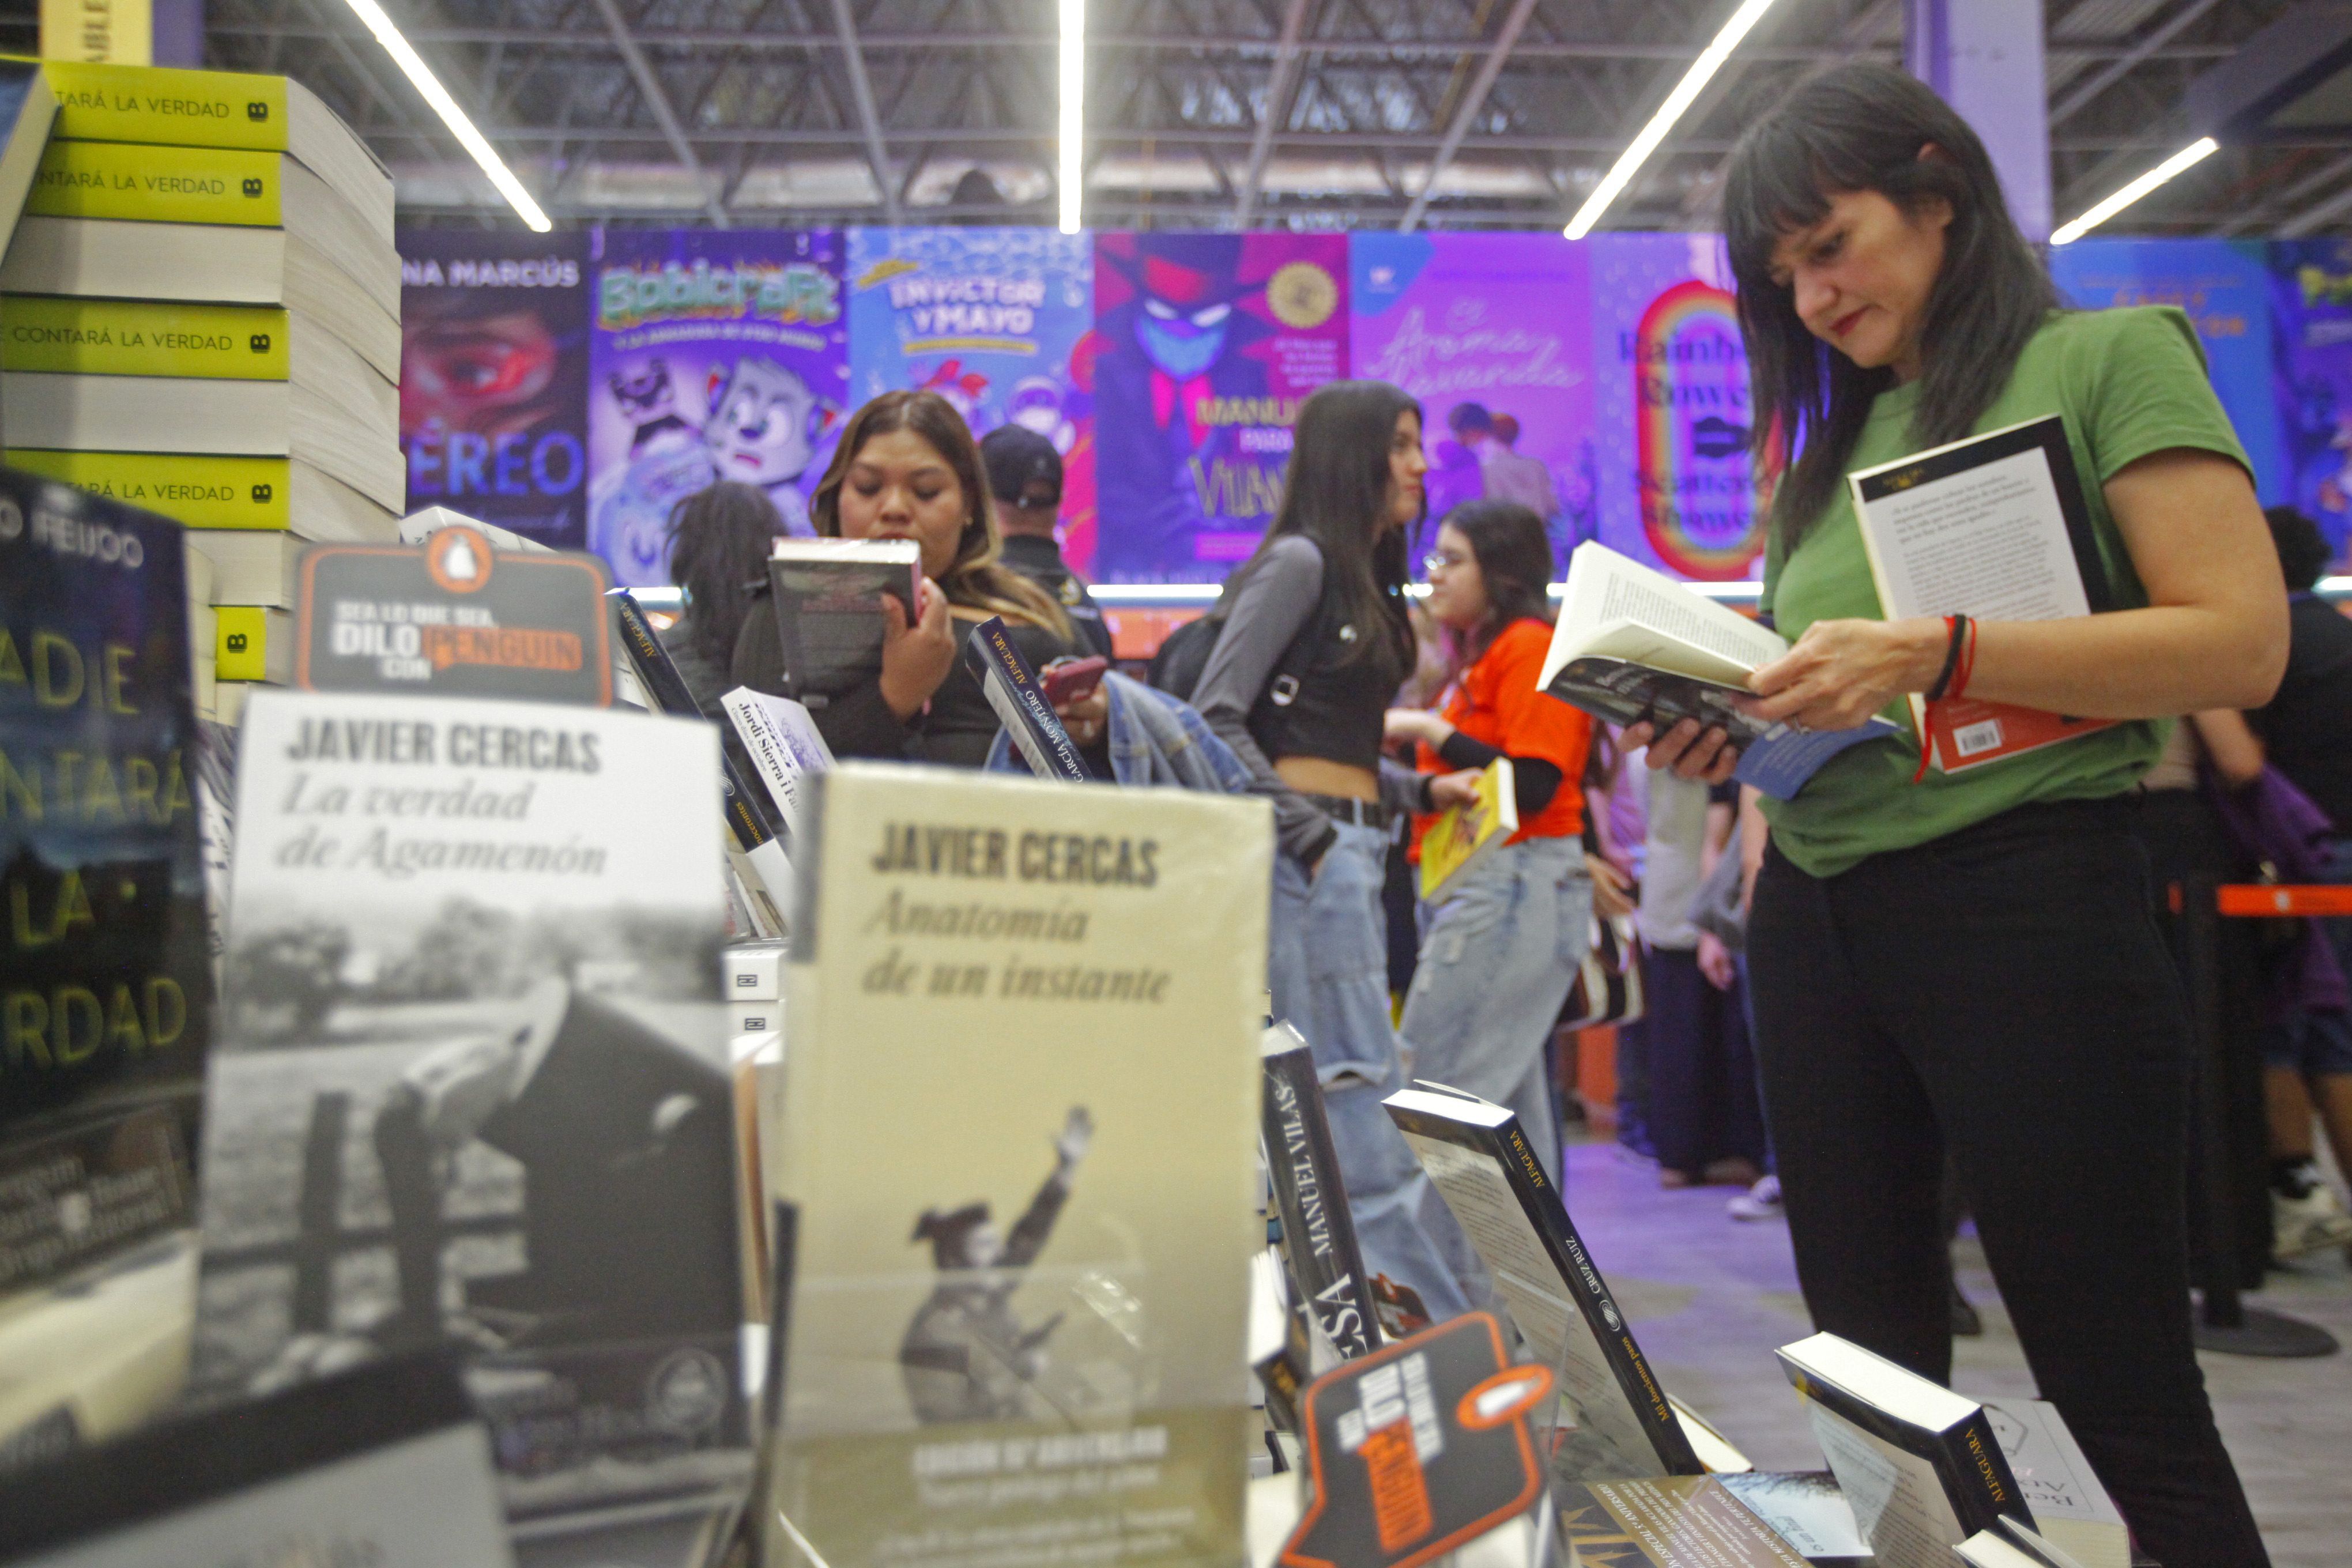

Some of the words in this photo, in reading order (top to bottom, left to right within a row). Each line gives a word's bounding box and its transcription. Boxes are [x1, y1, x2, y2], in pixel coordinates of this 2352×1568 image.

[115, 96, 140, 111] LA
[149, 98, 229, 118] VERDAD
[114, 175, 138, 190] LA
[146, 176, 225, 195] VERDAD
[13, 325, 113, 346] CONTARÁ
[121, 332, 145, 347] LA
[153, 333, 233, 351] VERDAD
[399, 419, 585, 496] ÉREO
[64, 480, 114, 496] RÁ
[124, 485, 146, 499] LA
[153, 485, 234, 502] VERDAD
[992, 632, 1028, 684] ALFAGUARA
[1026, 691, 1061, 744] MONTERO
[286, 717, 436, 767] JAVIER
[447, 721, 601, 775] CERCAS
[739, 702, 766, 734] Jordi
[757, 737, 784, 781] Sierra
[781, 779, 791, 789] i
[1058, 744, 1083, 783] GARCÍA
[281, 771, 346, 817] La
[363, 778, 536, 821] verdad
[277, 824, 341, 870] de
[348, 824, 609, 880] Agamenón
[870, 820, 1009, 877] JAVIER
[1018, 827, 1161, 889] CERCAS
[864, 887, 1091, 943] Anatomía
[862, 947, 918, 997] de
[928, 964, 988, 998] un
[1000, 953, 1173, 1004] instante
[1276, 1086, 1306, 1154] VILAS
[1510, 1130, 1545, 1188] ALFAGUARA
[1294, 1155, 1332, 1257] MANUEL
[1565, 1236, 1584, 1264] RUIZ
[1580, 1263, 1600, 1294] CRUZ
[1622, 1337, 1639, 1360] pasos
[1635, 1360, 1660, 1403] doscientos
[1654, 1404, 1669, 1422] Mil
[1965, 1428, 2006, 1502] ALFAGUARA
[1596, 1483, 1639, 1521] ANIVERSARIO
[1651, 1505, 1682, 1528] GANADORA
[1637, 1529, 1674, 1558] ESPECIAL
[1675, 1516, 1705, 1537] FINALISTA
[1747, 1526, 1785, 1552] HISTORIA
